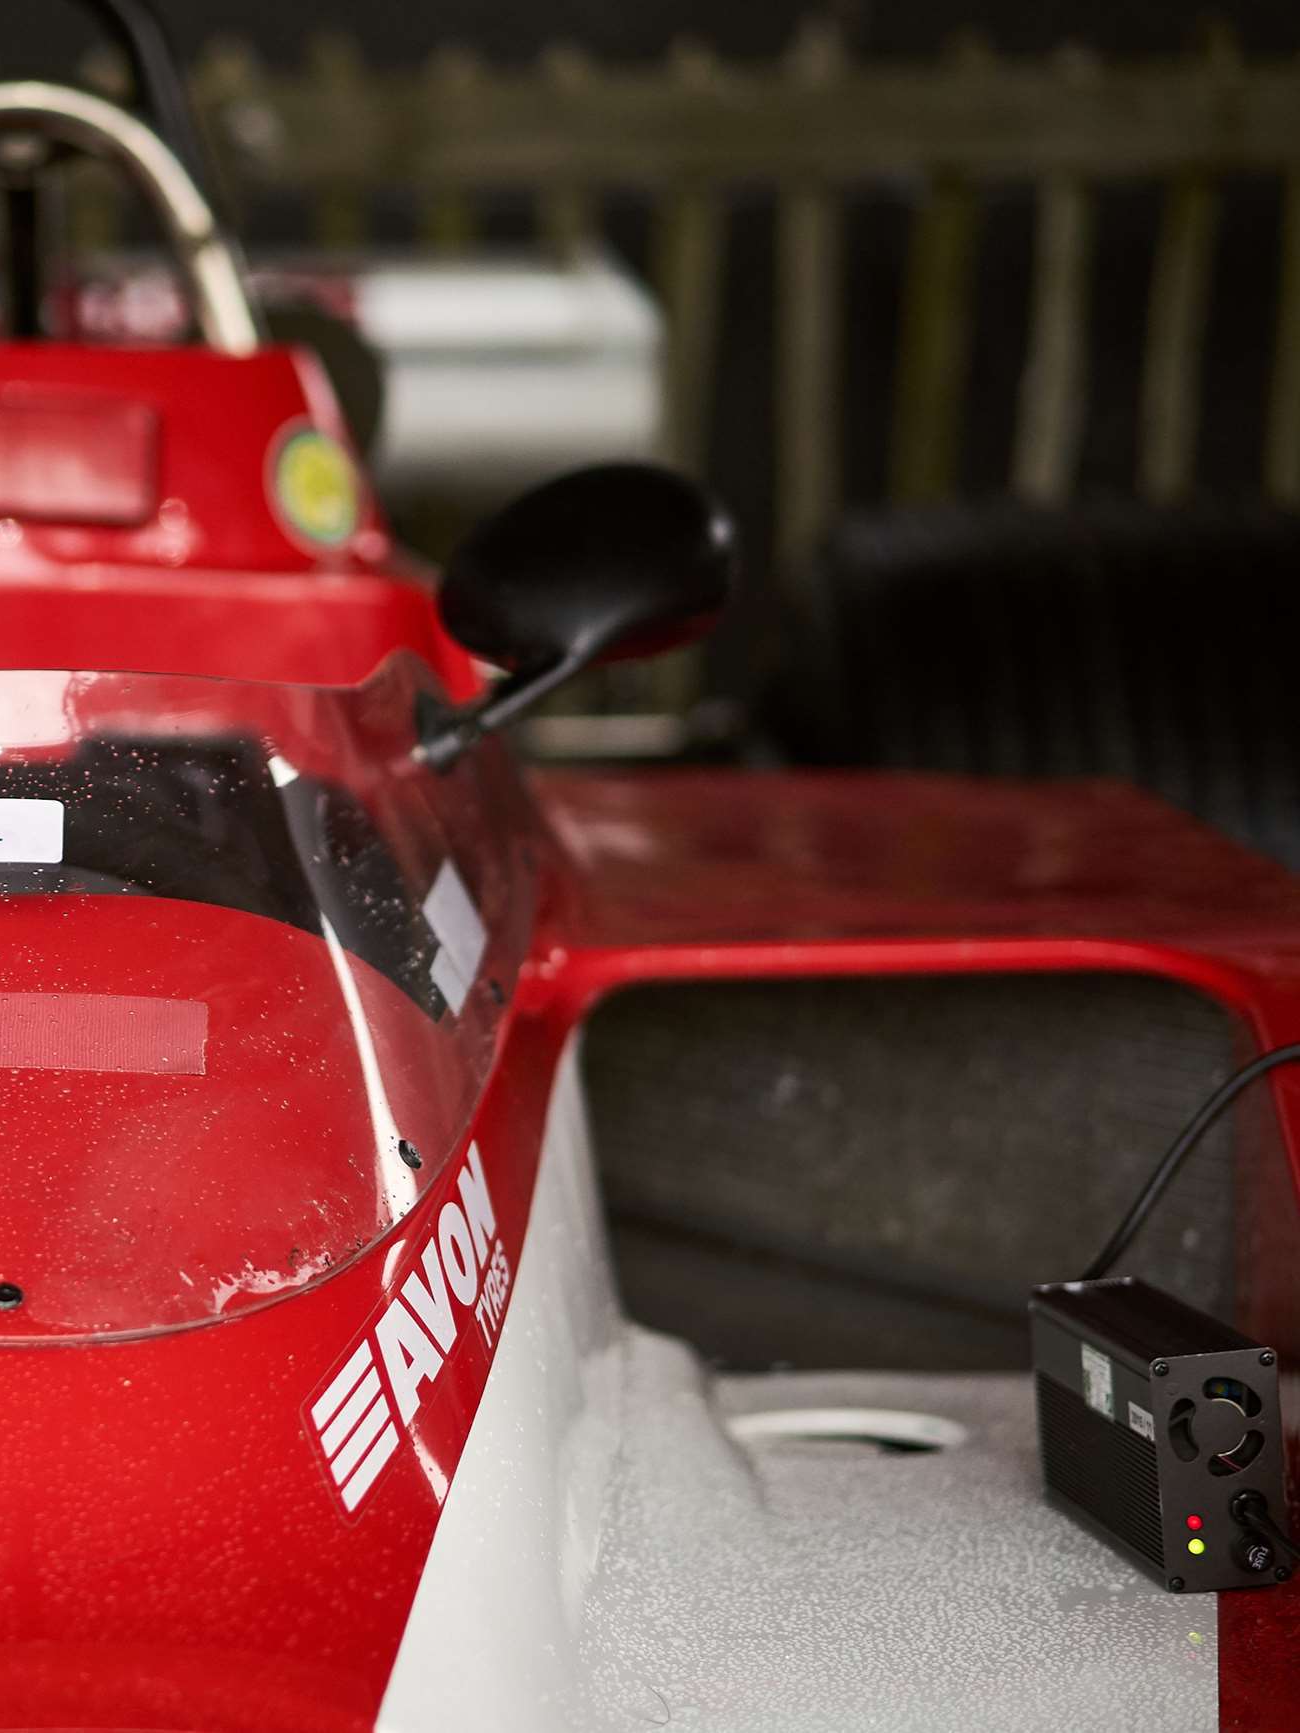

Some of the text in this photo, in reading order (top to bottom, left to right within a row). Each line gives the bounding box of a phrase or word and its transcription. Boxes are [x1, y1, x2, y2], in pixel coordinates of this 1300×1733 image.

[374, 1140, 496, 1428] AVON
[475, 1239, 509, 1348] TYRES
[1251, 1546, 1269, 1570] FUSE
